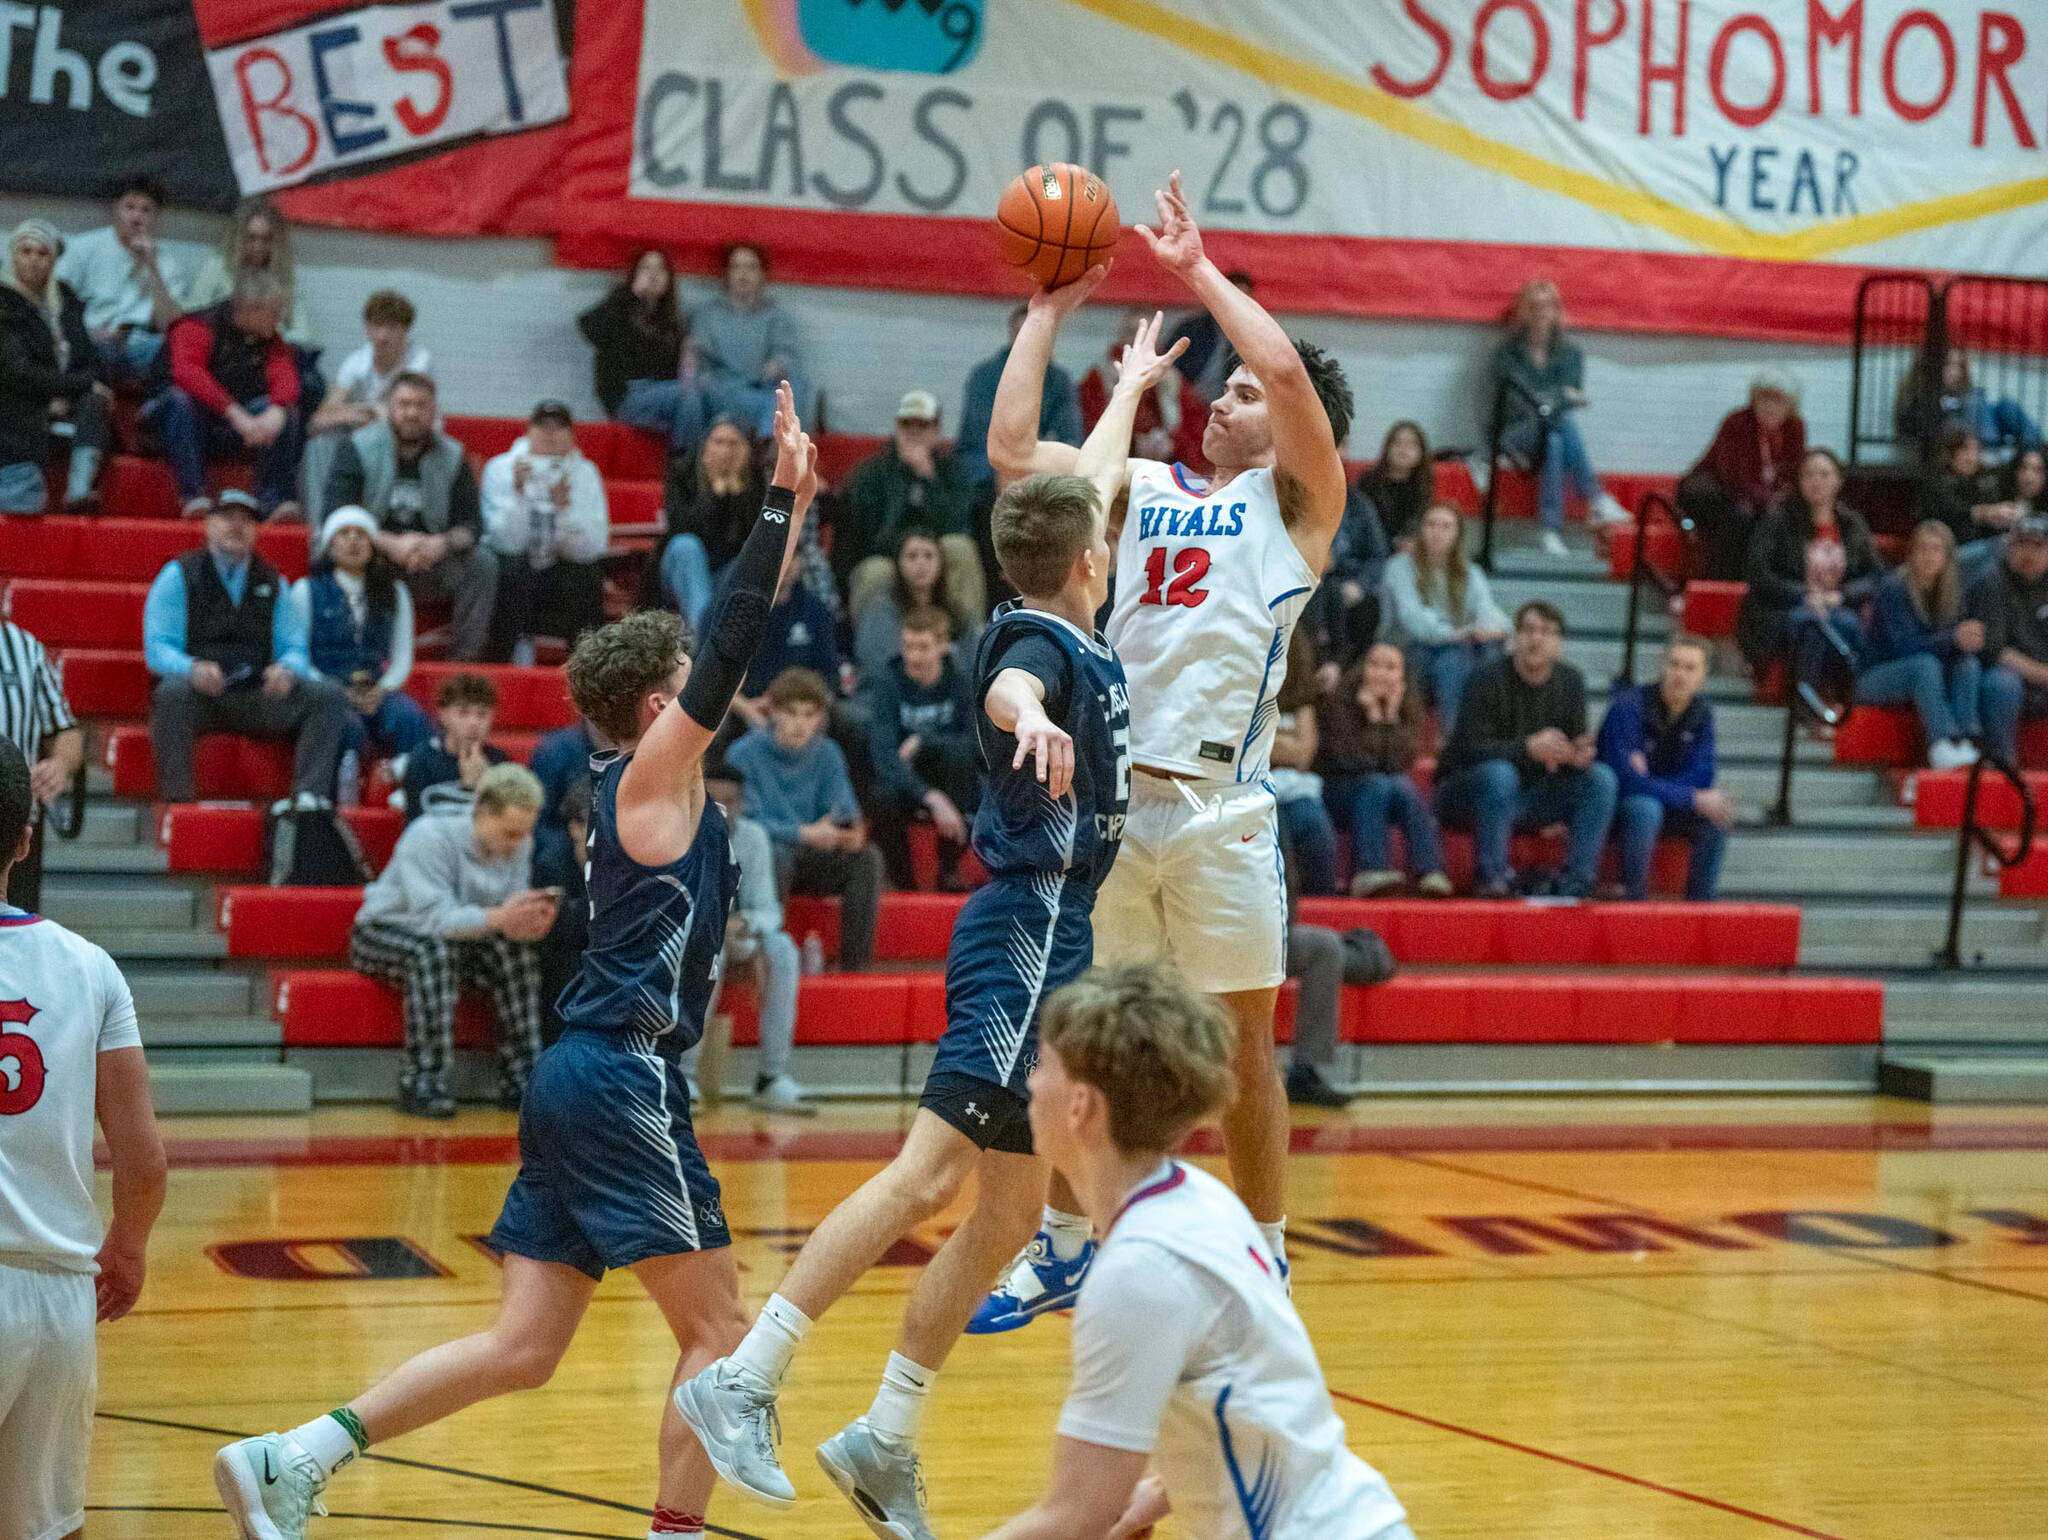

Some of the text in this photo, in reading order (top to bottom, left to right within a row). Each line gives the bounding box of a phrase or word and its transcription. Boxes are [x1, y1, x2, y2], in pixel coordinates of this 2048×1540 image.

[0, 1, 159, 118] The
[234, 0, 543, 176] BEST
[637, 70, 974, 211] CLASS
[1169, 87, 1311, 218] '28
[1708, 145, 1861, 216] YEAR
[1138, 502, 1247, 542] RIVALS
[1138, 546, 1213, 608] 12
[0, 997, 49, 1116] 5
